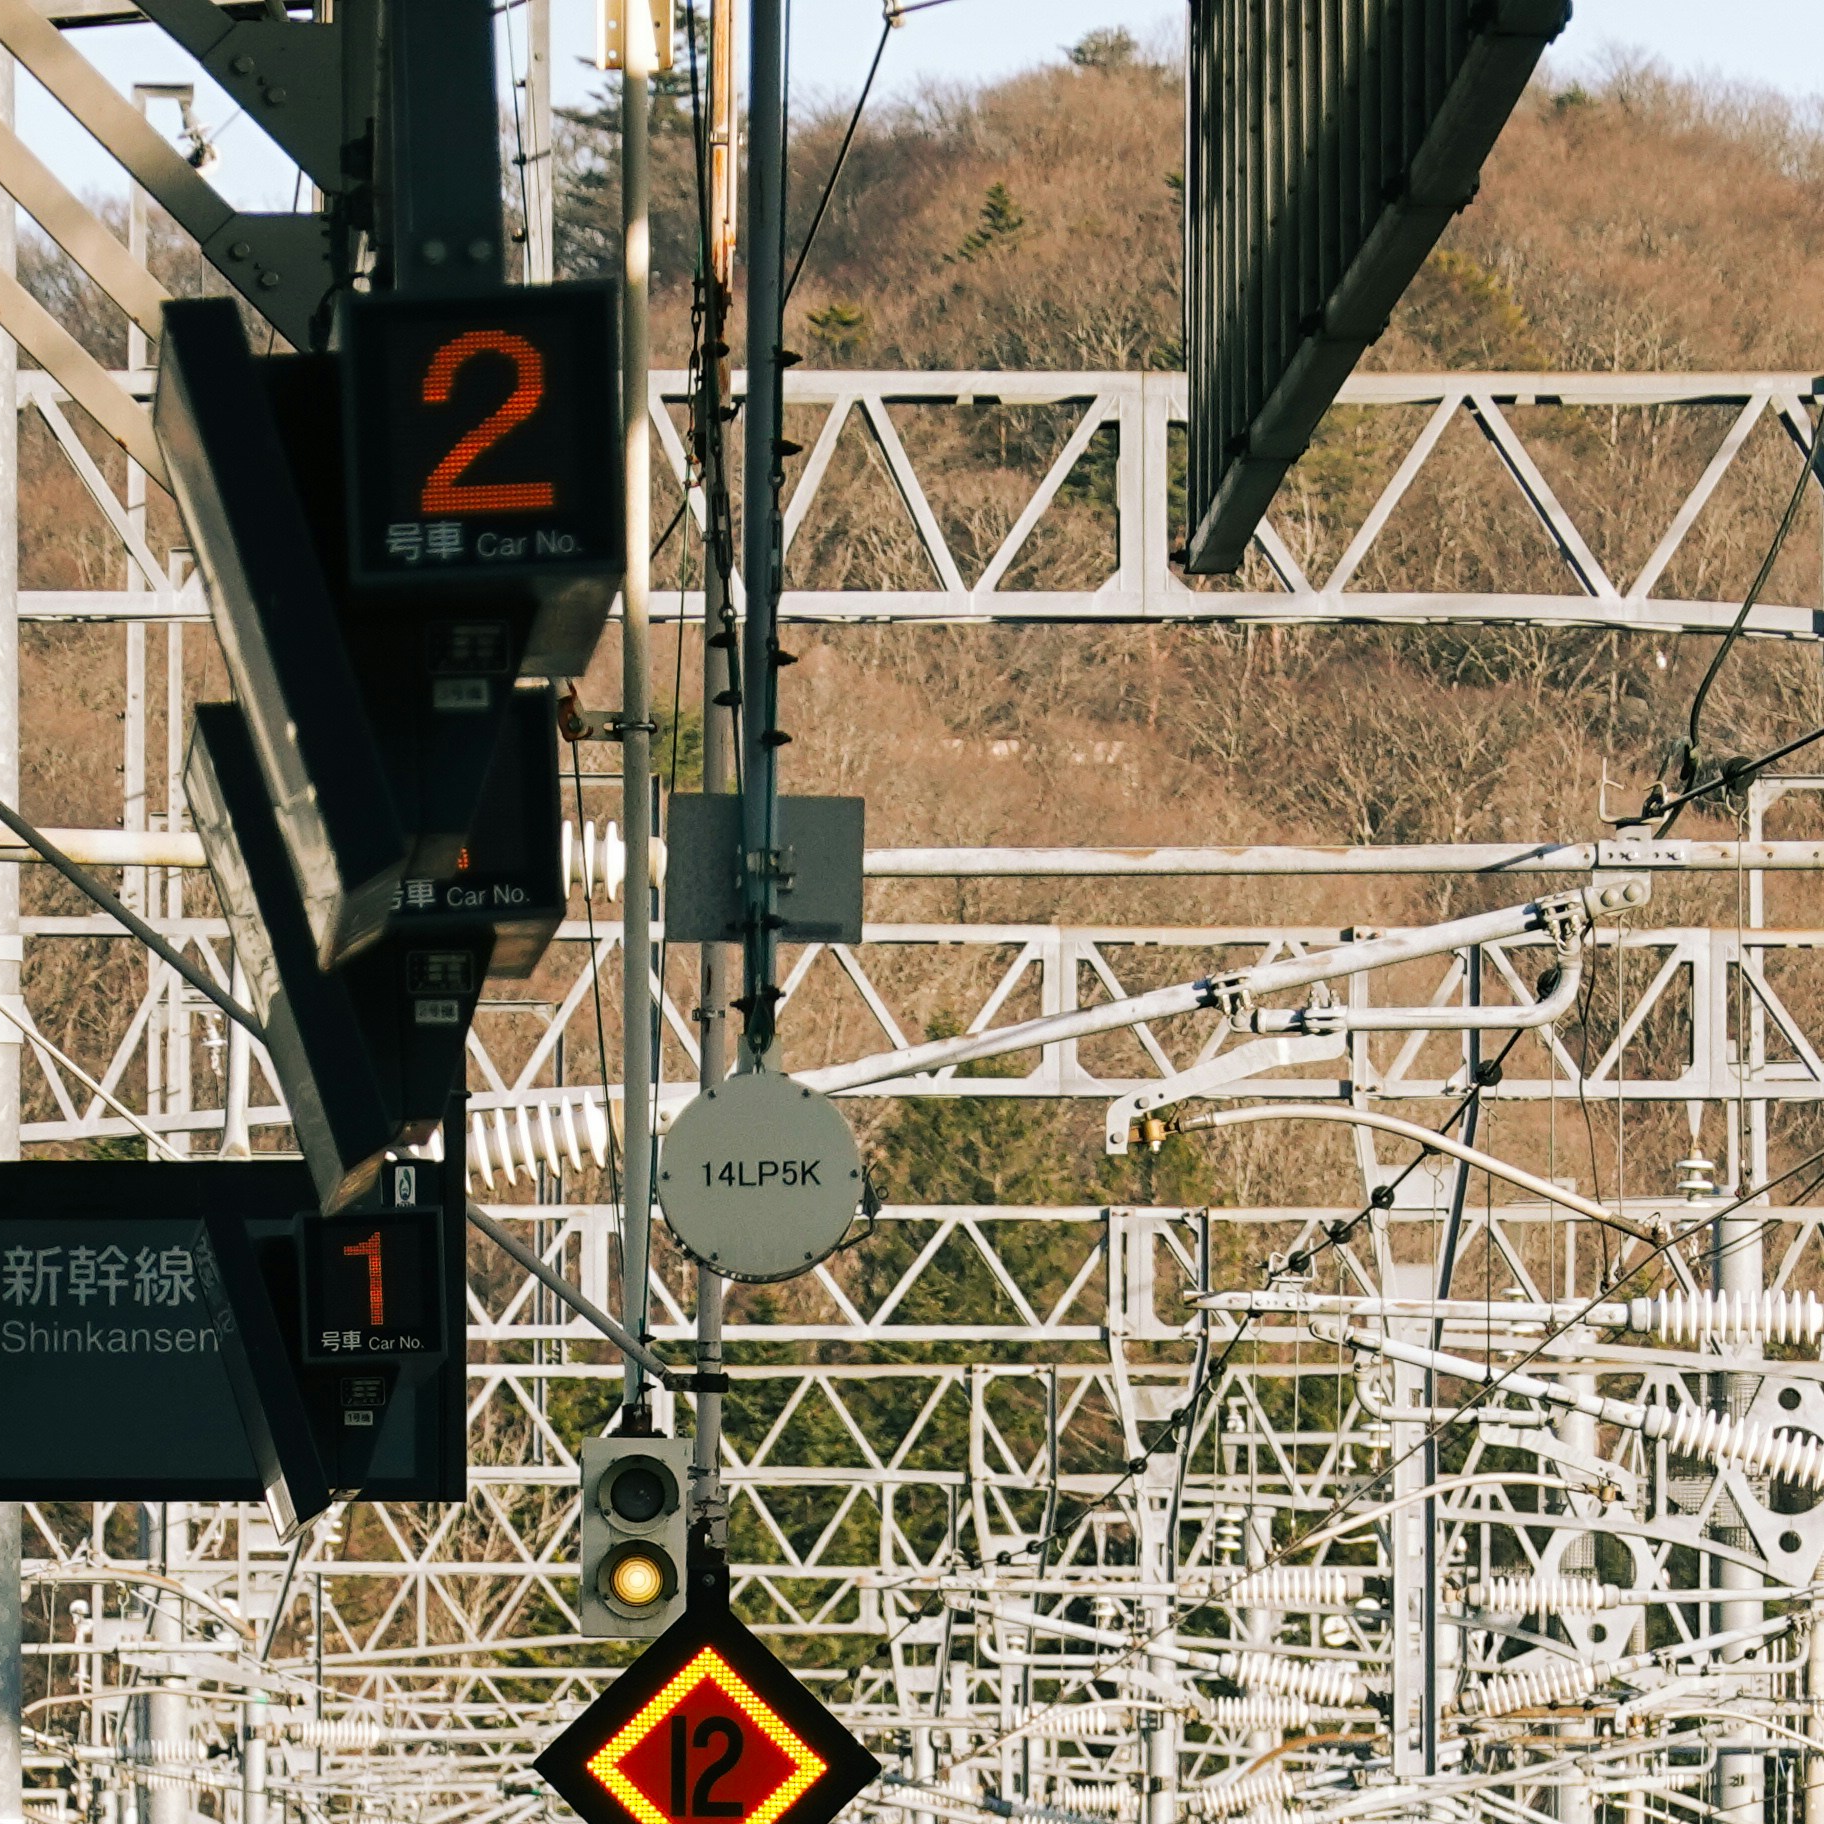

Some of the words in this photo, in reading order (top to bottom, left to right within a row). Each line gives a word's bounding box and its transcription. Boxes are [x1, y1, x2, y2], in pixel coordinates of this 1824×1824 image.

[421, 330, 554, 513] 2
[385, 521, 465, 561] 号車
[476, 532, 524, 559] Car
[534, 527, 583, 555] No.
[446, 886, 487, 907] Car
[493, 884, 531, 905] No.
[702, 1159, 822, 1187] 14LP5K
[1, 1245, 197, 1307] 新幹線
[343, 1231, 384, 1326] 1
[1, 1320, 220, 1354] Shinkansen
[321, 1329, 362, 1352] 号車
[368, 1335, 395, 1351] Car
[399, 1335, 425, 1350] No.
[670, 1715, 745, 1819] 12
